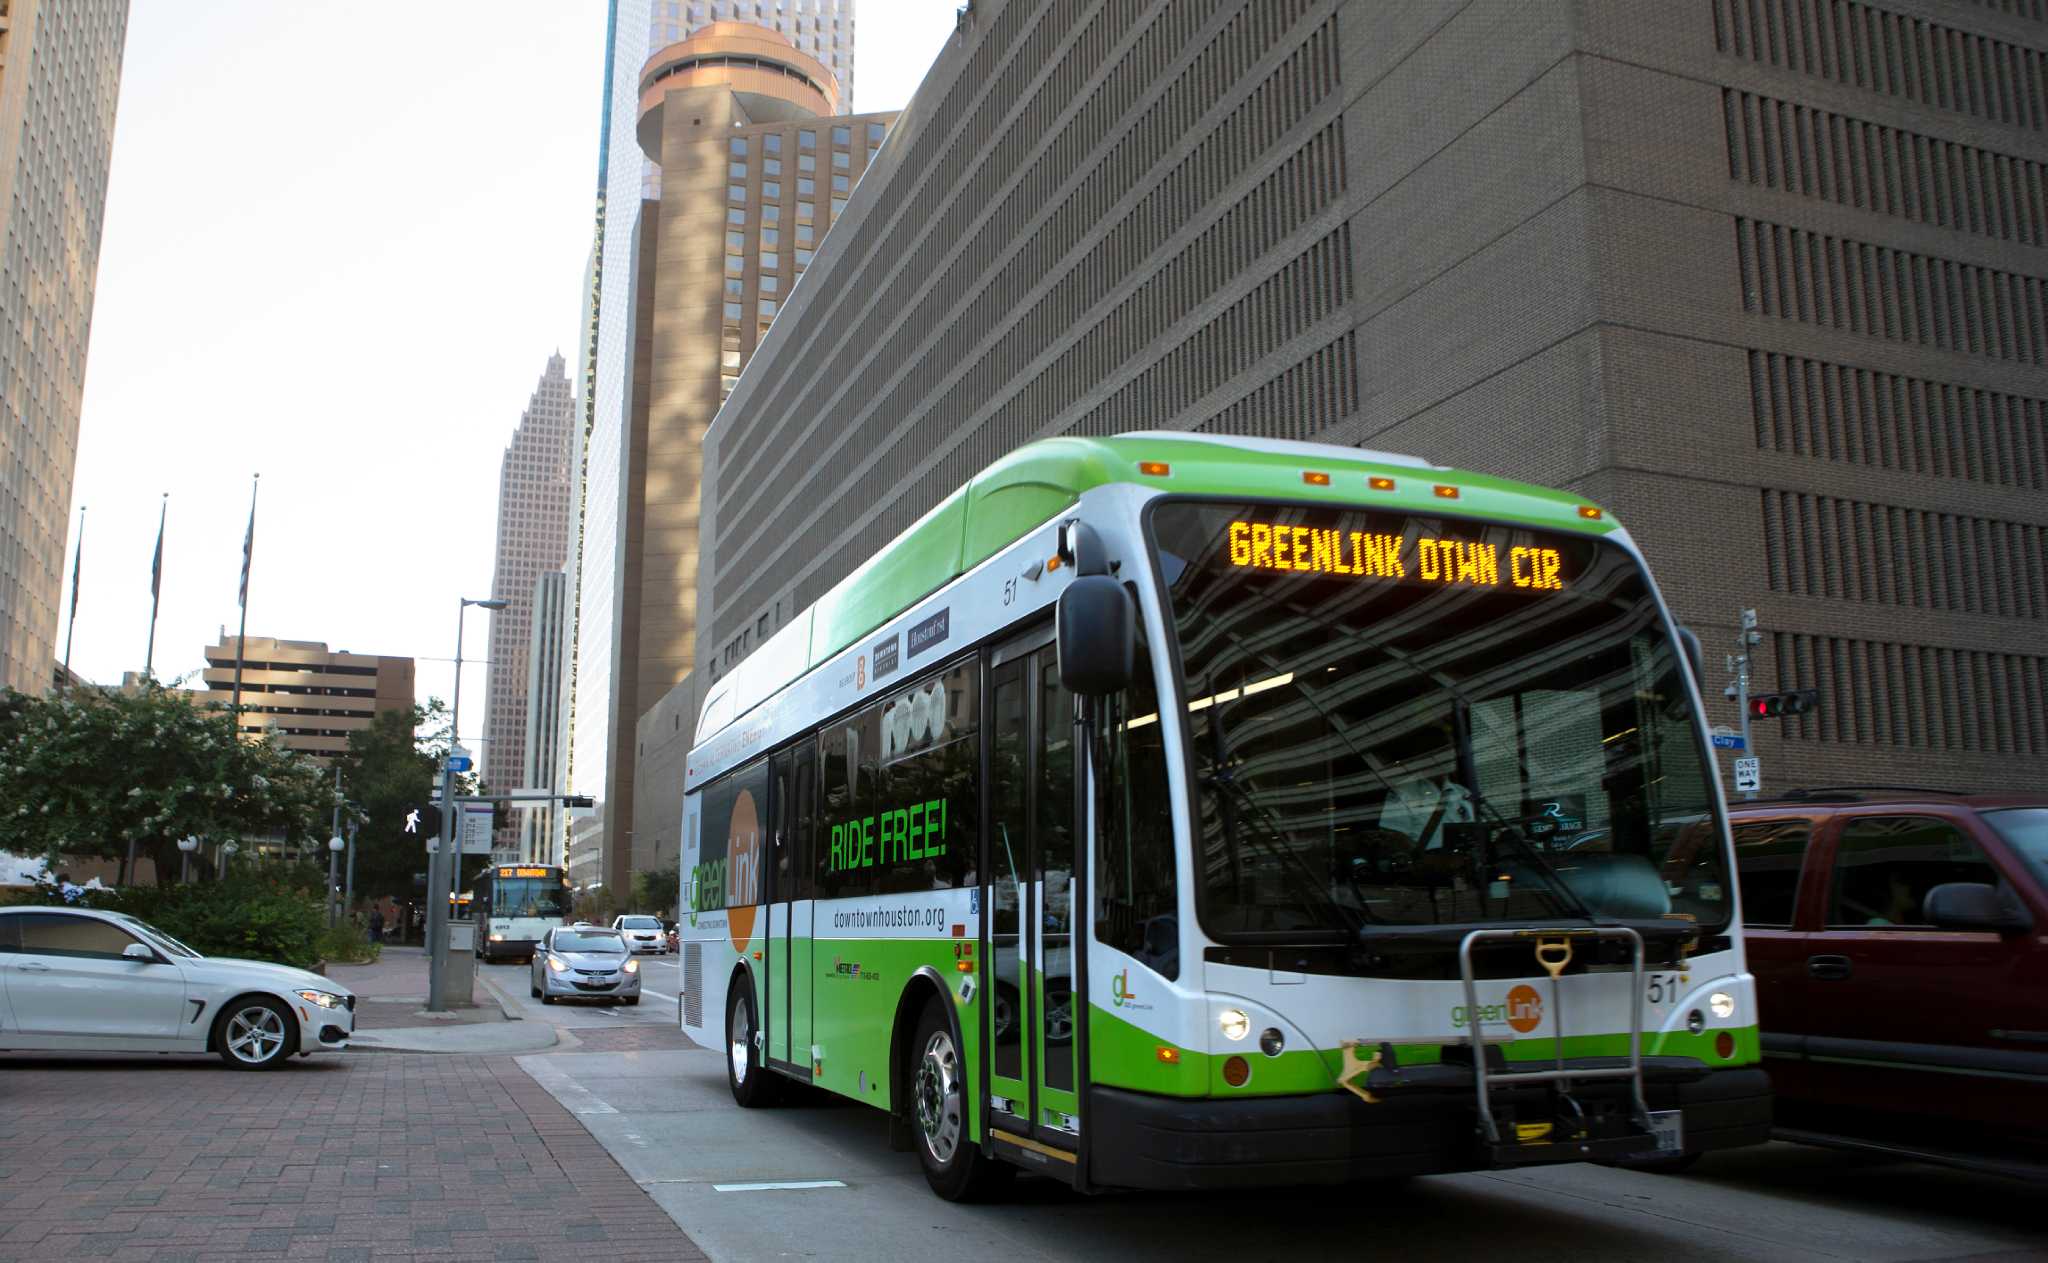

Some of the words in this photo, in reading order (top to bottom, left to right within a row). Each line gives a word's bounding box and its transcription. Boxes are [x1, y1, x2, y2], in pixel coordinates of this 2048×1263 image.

[1228, 521, 1406, 579] GREENLINK
[1418, 538, 1498, 585] DTWN
[1510, 546, 1562, 590] CIR
[1003, 576, 1017, 606] 51
[1737, 760, 1757, 769] ONE
[1738, 769, 1757, 778] WAY
[831, 816, 875, 872] RIDE
[880, 797, 947, 865] FREE!
[834, 905, 945, 932] downtownhouston.org
[1647, 974, 1676, 1004] 51
